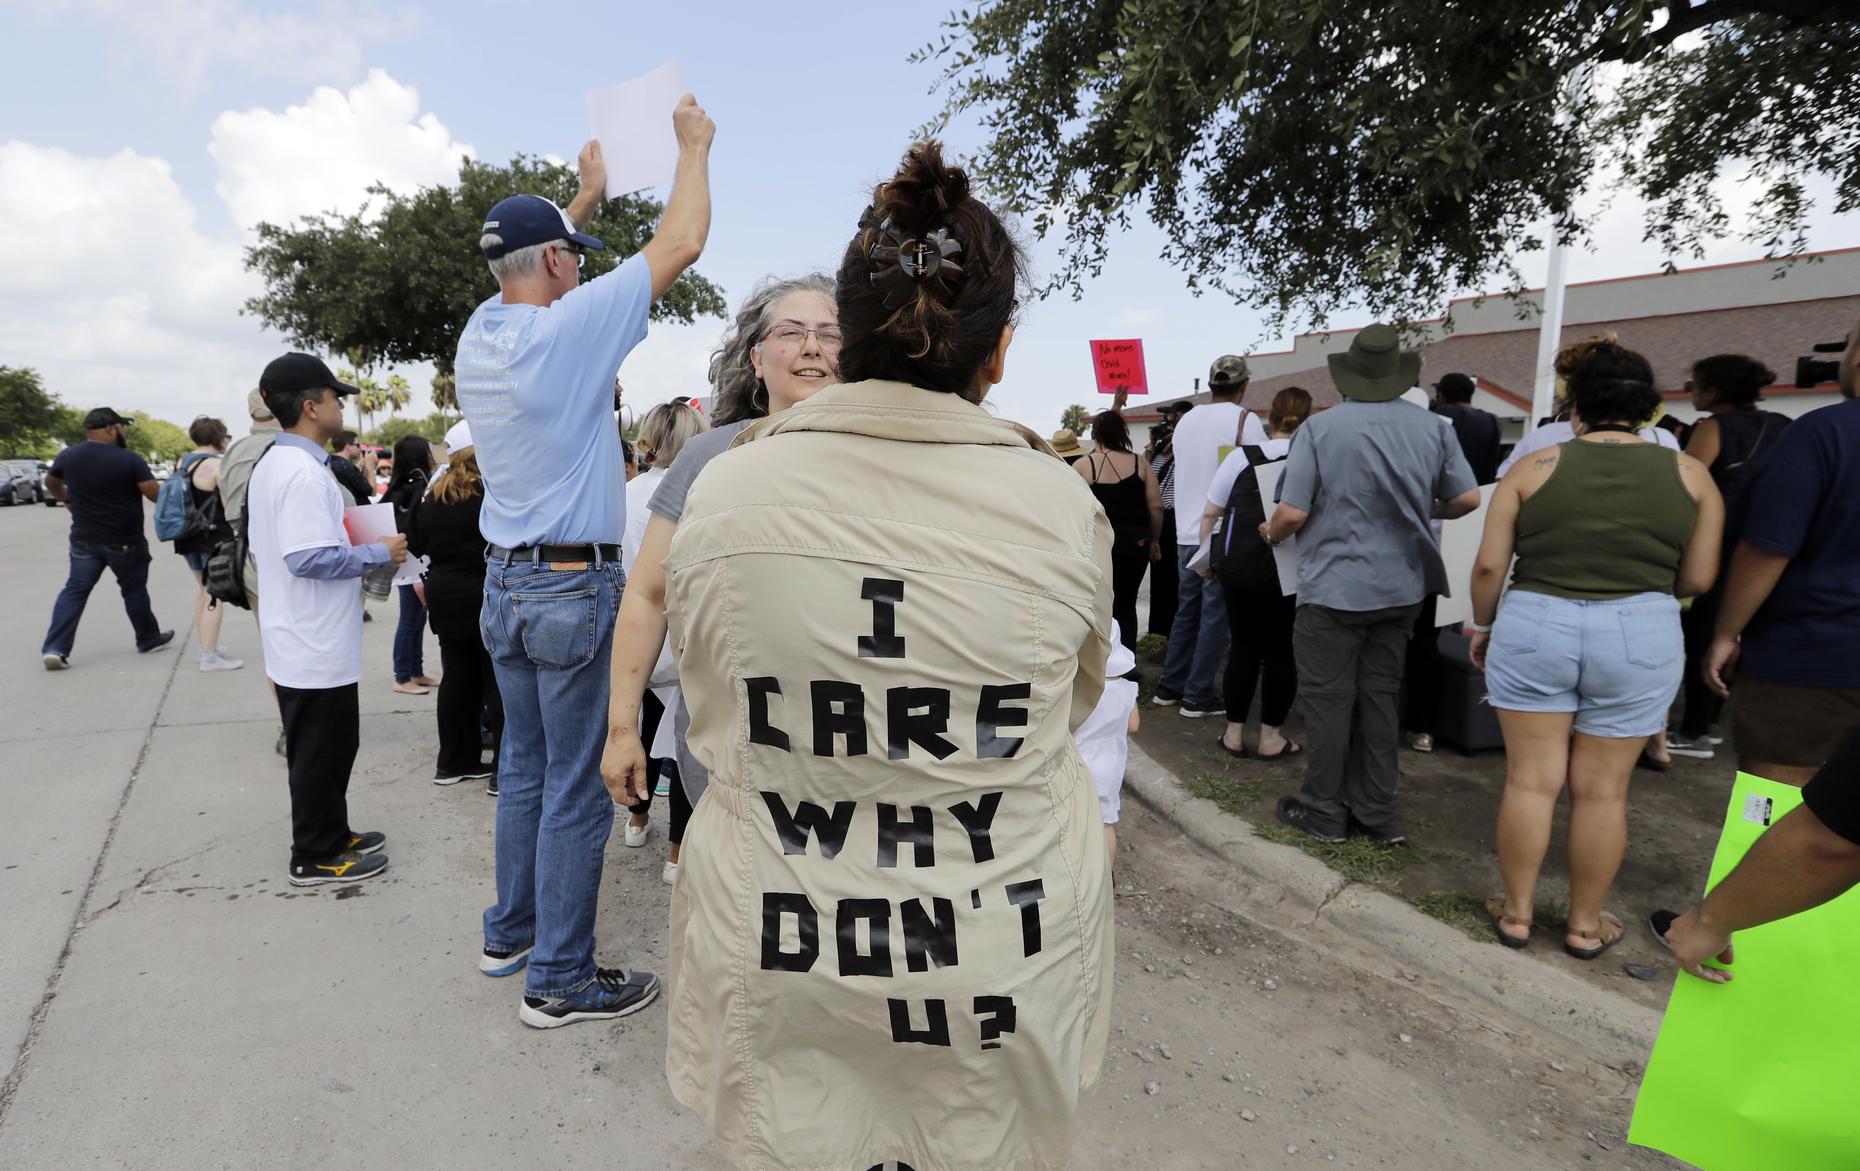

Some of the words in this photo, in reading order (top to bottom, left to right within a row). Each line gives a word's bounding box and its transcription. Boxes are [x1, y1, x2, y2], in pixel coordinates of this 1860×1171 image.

[1113, 344, 1135, 353] more
[858, 578, 905, 658] I
[743, 677, 1031, 760] CARE
[759, 791, 1003, 867] WHY
[760, 879, 1045, 977] DON'T
